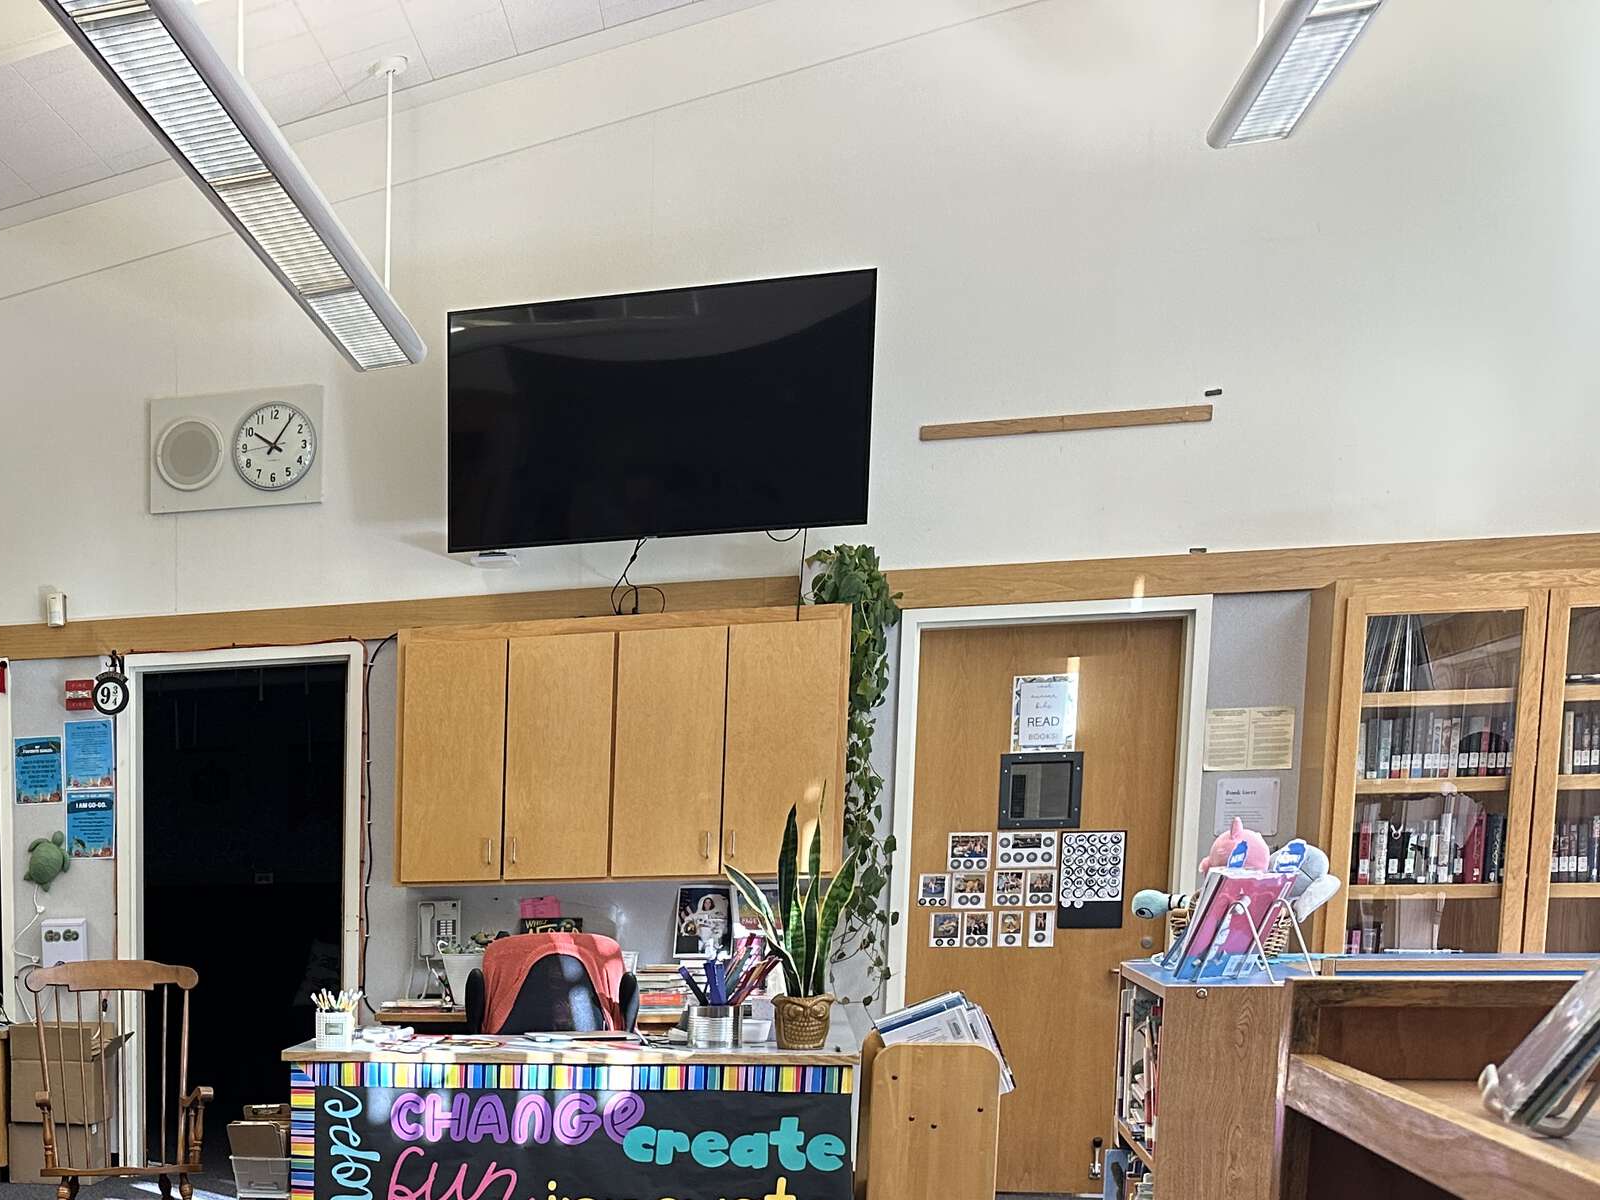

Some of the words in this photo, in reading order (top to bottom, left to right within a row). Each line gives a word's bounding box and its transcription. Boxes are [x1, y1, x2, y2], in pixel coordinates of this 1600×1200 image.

[257, 414, 264, 425] 11
[271, 409, 279, 420] 12
[245, 427, 254, 438] 10
[297, 424, 303, 434] 2
[241, 443, 248, 453] 9
[301, 439, 307, 449] 3
[245, 458, 251, 469] 8
[296, 455, 303, 465] 4
[256, 468, 262, 479] 7
[270, 472, 276, 482] 6
[285, 466, 291, 477] 5
[100, 686, 111, 705] 9
[1027, 716, 1060, 728] READ
[622, 1116, 846, 1172] create
